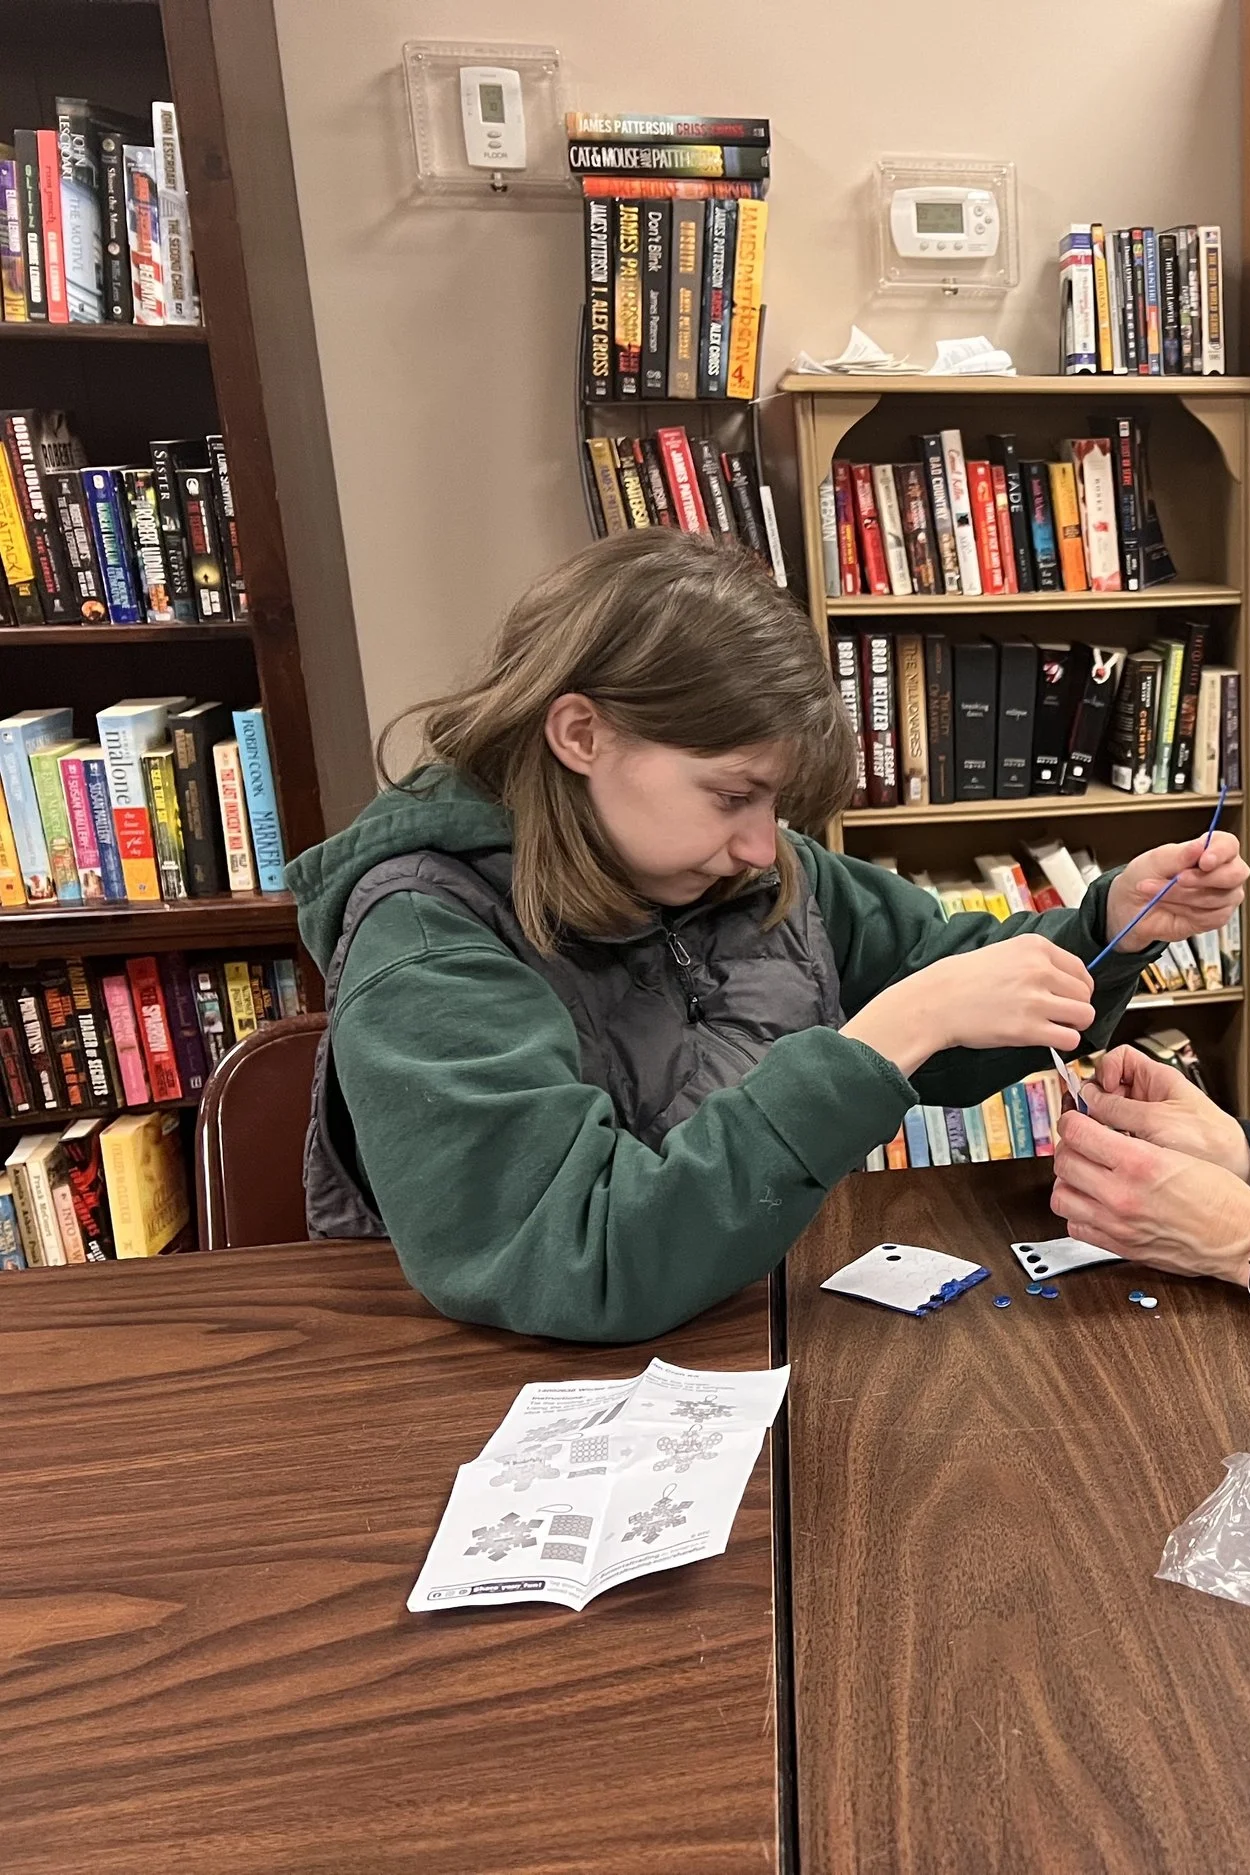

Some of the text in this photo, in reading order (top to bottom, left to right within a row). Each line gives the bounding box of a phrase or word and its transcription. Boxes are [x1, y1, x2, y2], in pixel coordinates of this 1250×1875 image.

[58, 115, 74, 182] LESCROART
[71, 133, 86, 167] JOHN
[579, 118, 612, 133] JAMES
[614, 119, 674, 136] PATTERSON
[619, 204, 639, 254] JAMES
[592, 300, 609, 331] ALEX
[592, 335, 609, 377] CROSS
[12, 416, 34, 461] ROBERT
[153, 449, 171, 501] SISTER
[134, 508, 159, 545] ROBERT
[871, 639, 889, 731] BRAD MELTZER
[105, 731, 134, 805] malone
[241, 719, 264, 798] ROBIN COOK
[252, 810, 281, 869] MARKER
